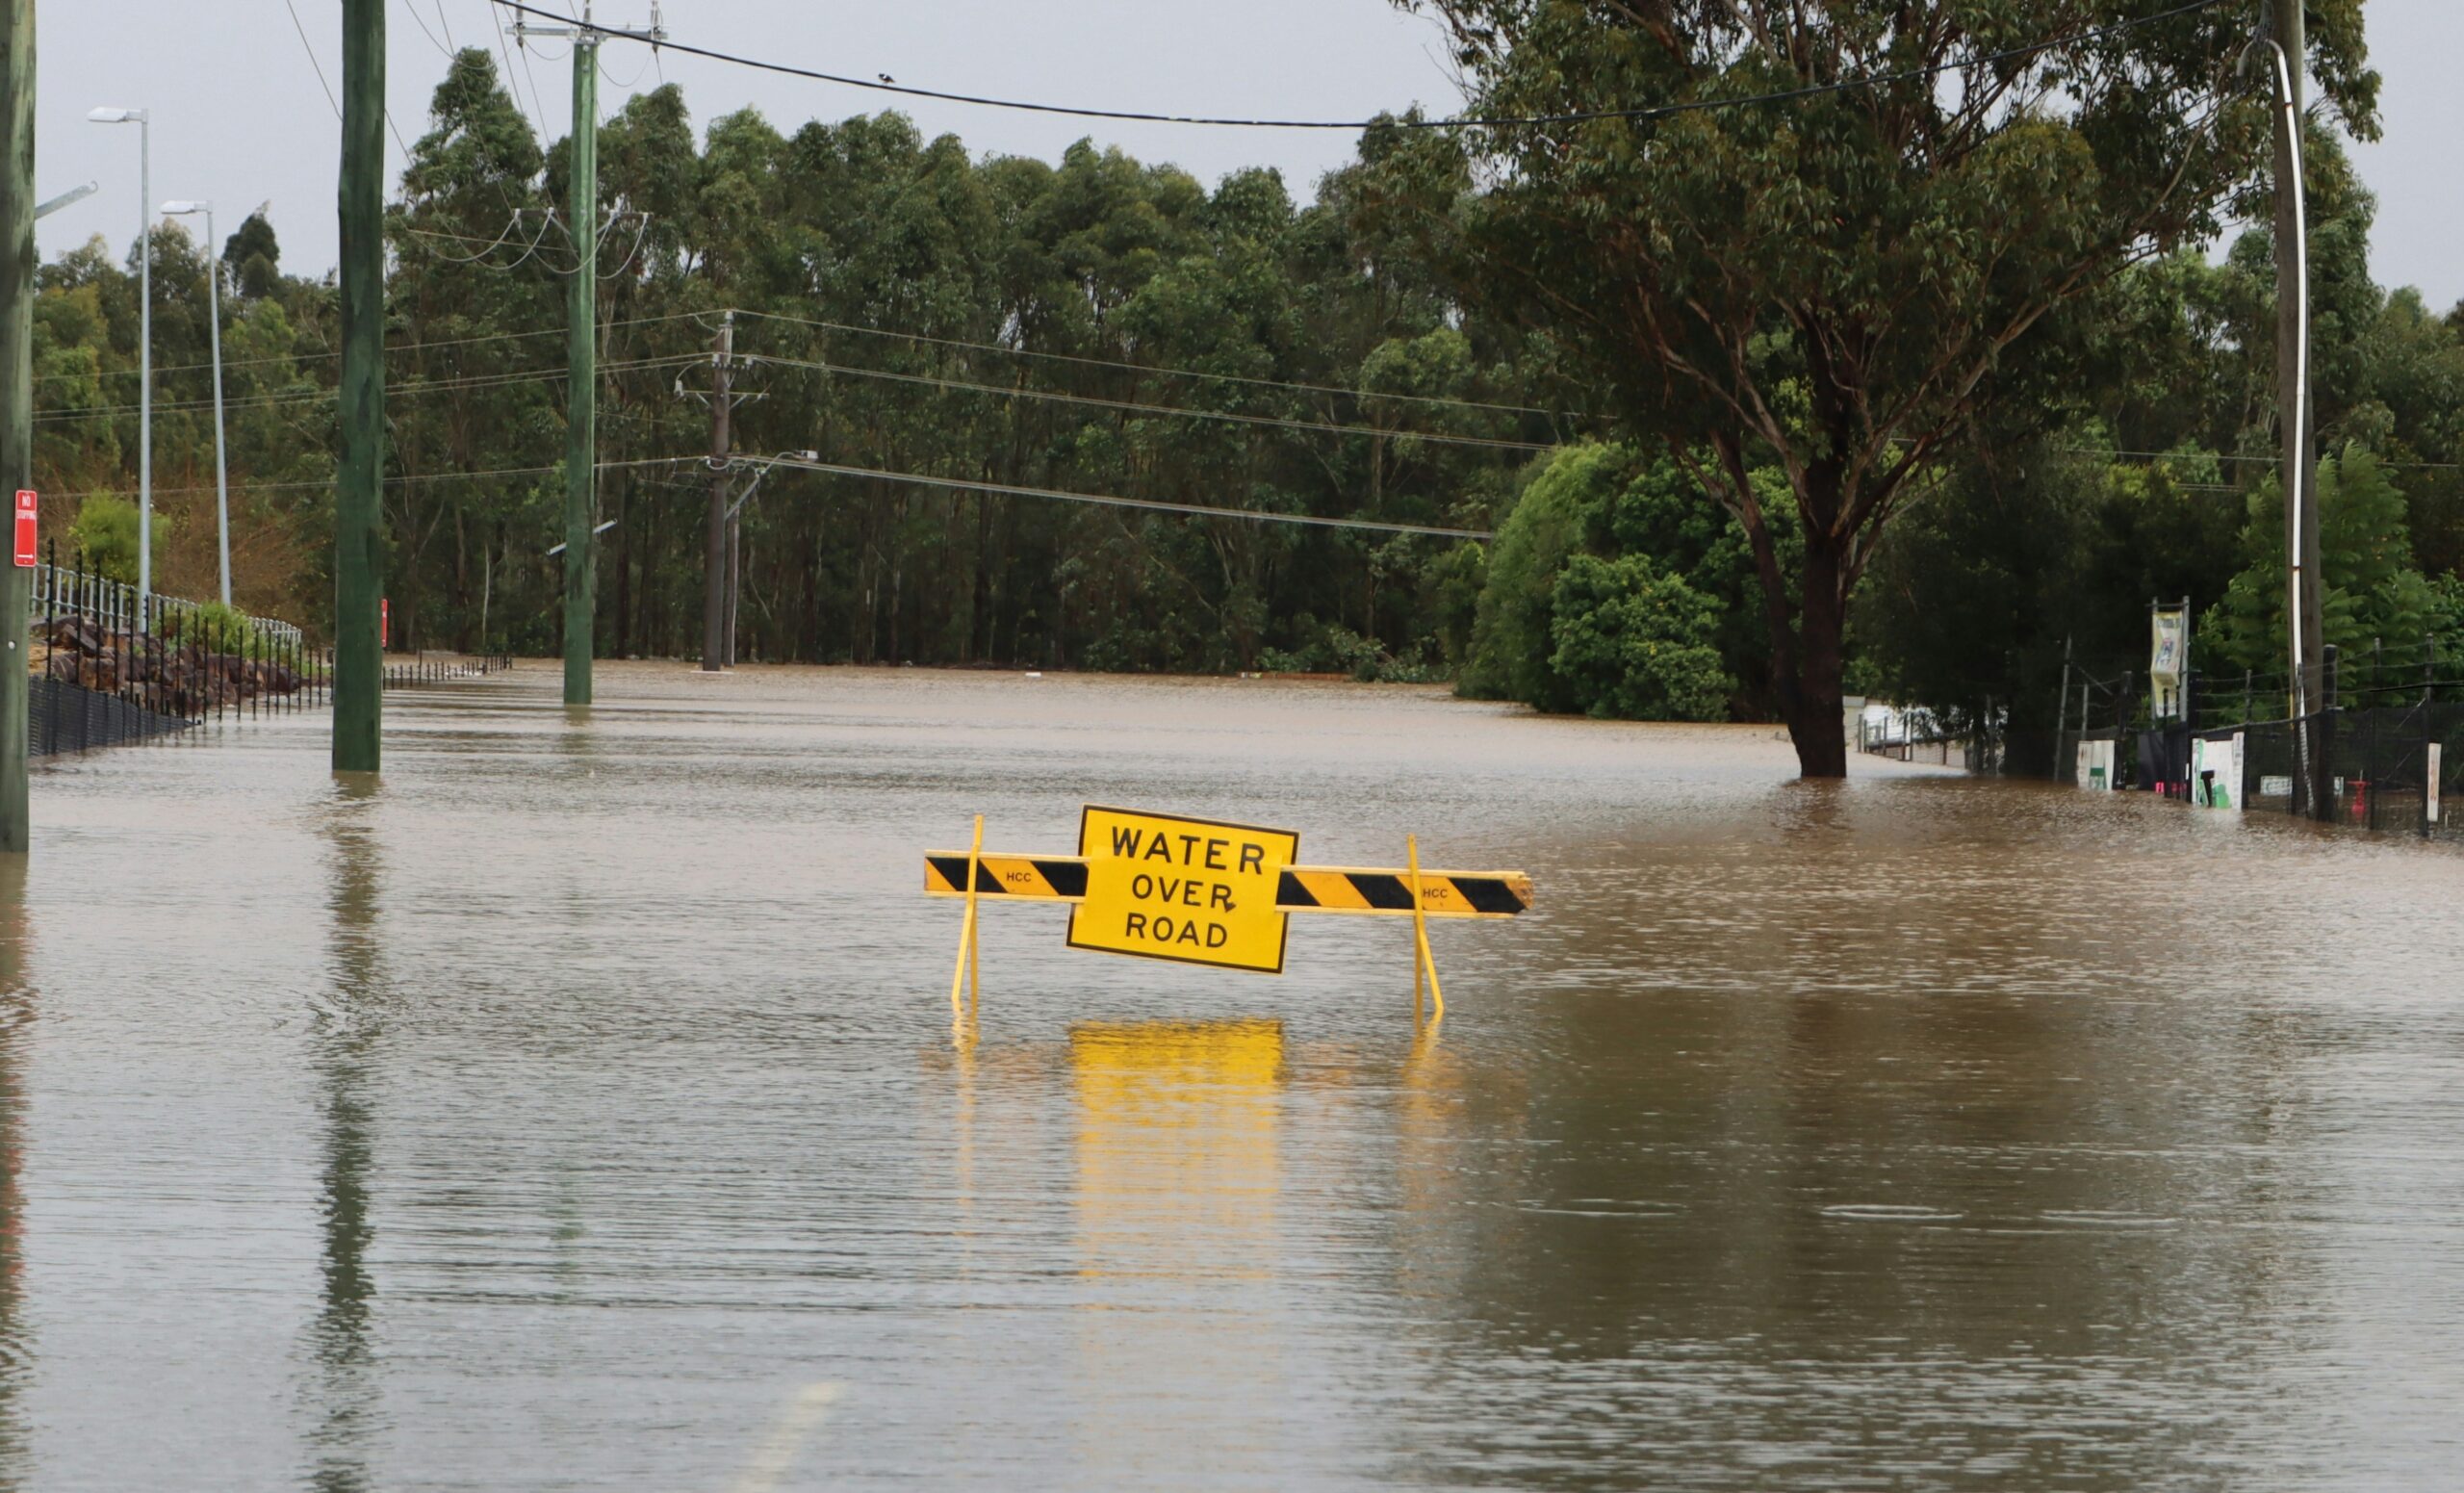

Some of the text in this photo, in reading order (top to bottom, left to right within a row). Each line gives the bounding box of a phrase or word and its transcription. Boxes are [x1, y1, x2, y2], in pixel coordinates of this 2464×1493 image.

[22, 495, 31, 507] NO
[1112, 826, 1265, 875] WATER
[1006, 871, 1032, 883] HCC
[1132, 874, 1234, 912] OVER
[1423, 888, 1448, 899] HCC
[1125, 912, 1228, 948] ROAD
